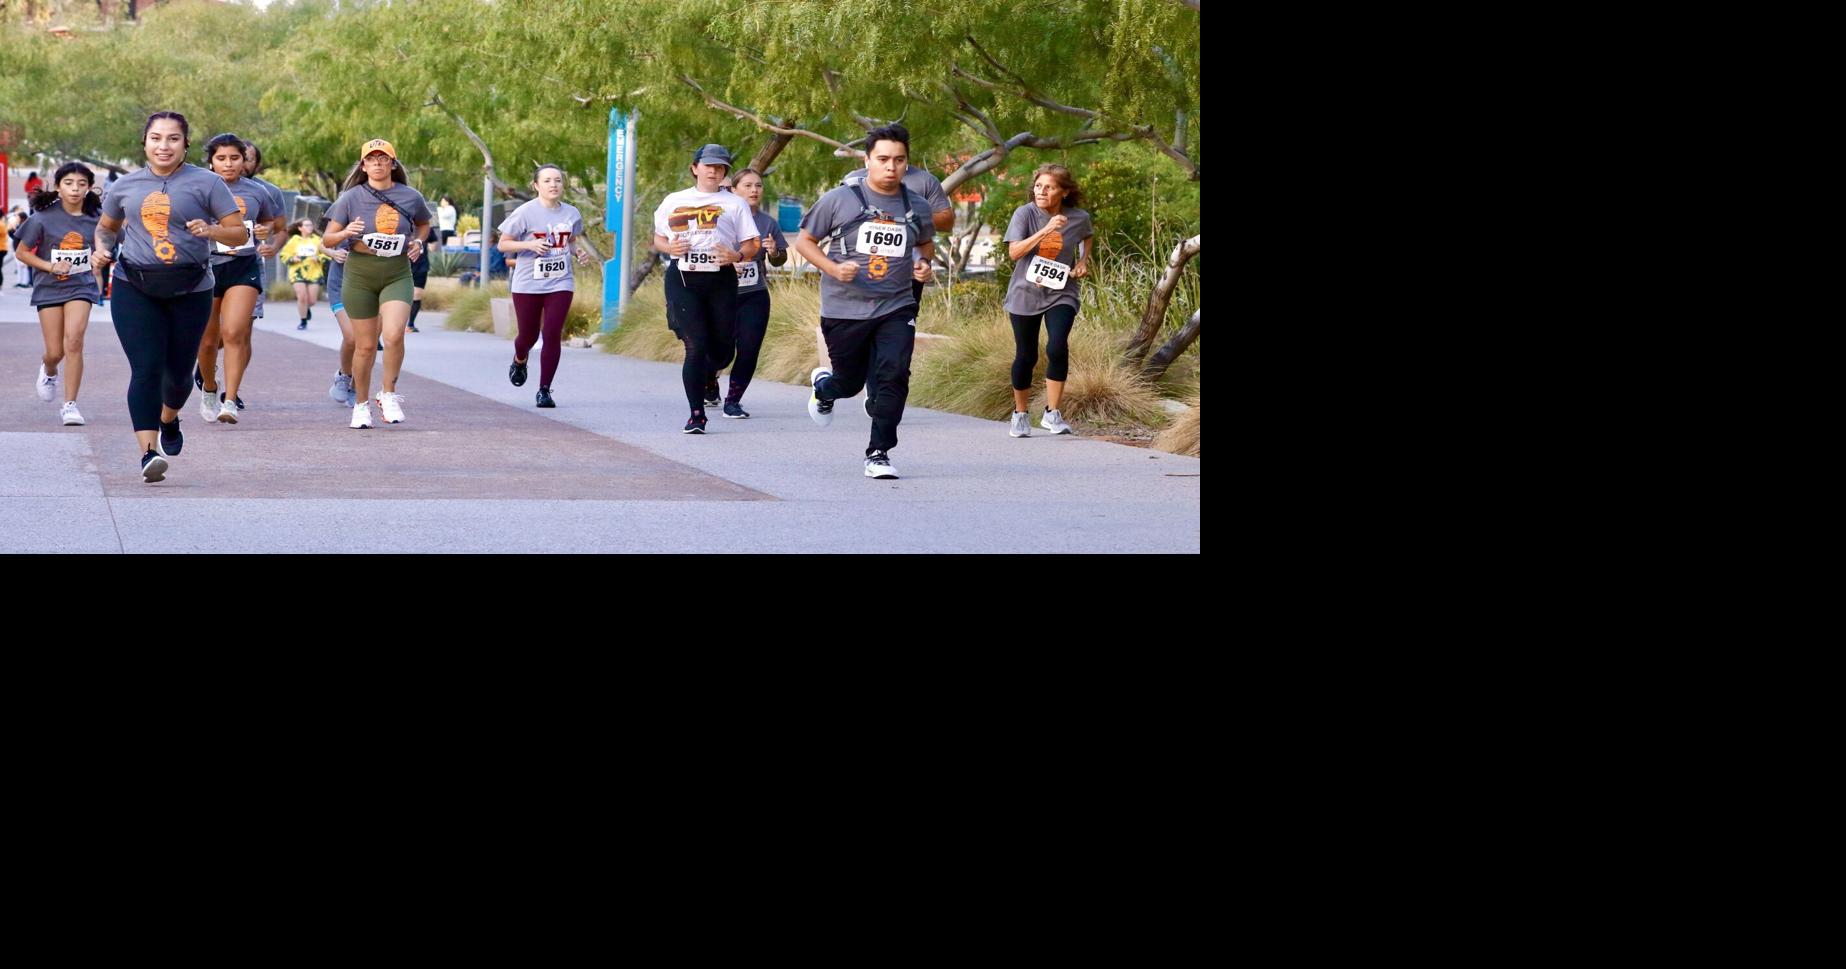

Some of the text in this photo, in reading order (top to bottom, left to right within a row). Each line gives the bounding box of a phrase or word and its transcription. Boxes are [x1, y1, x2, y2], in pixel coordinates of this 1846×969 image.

[615, 129, 625, 203] EMERGENCY
[367, 238, 399, 250] 1581
[864, 230, 903, 247] 1690
[538, 261, 565, 272] 1620
[738, 267, 756, 279] 73
[1034, 263, 1065, 282] 1594
